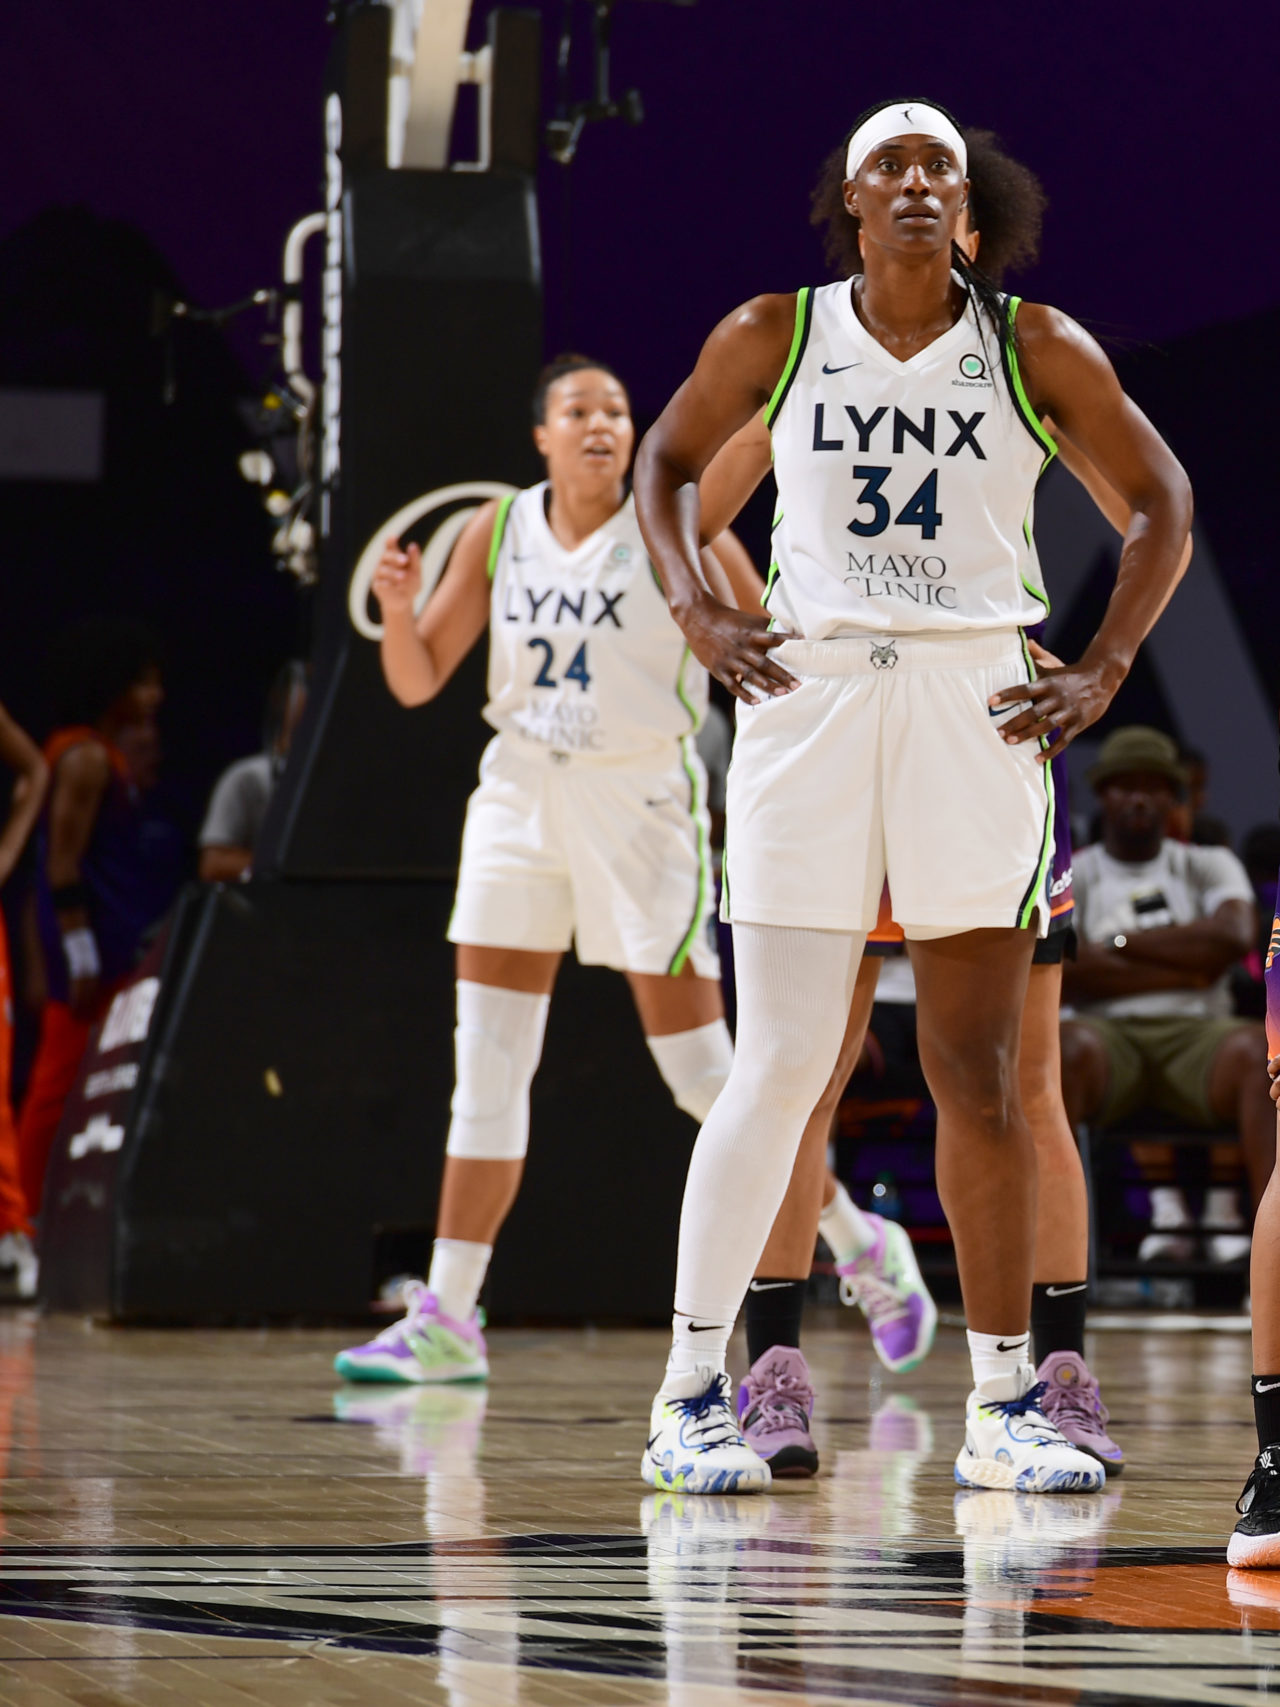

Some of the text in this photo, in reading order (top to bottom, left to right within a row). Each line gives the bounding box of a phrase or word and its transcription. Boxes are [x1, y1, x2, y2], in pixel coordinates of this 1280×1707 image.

[812, 402, 988, 461] LYNX
[846, 464, 943, 541] 34
[845, 550, 947, 580] MAYO
[505, 586, 626, 630] LYNX
[526, 637, 591, 692] 24
